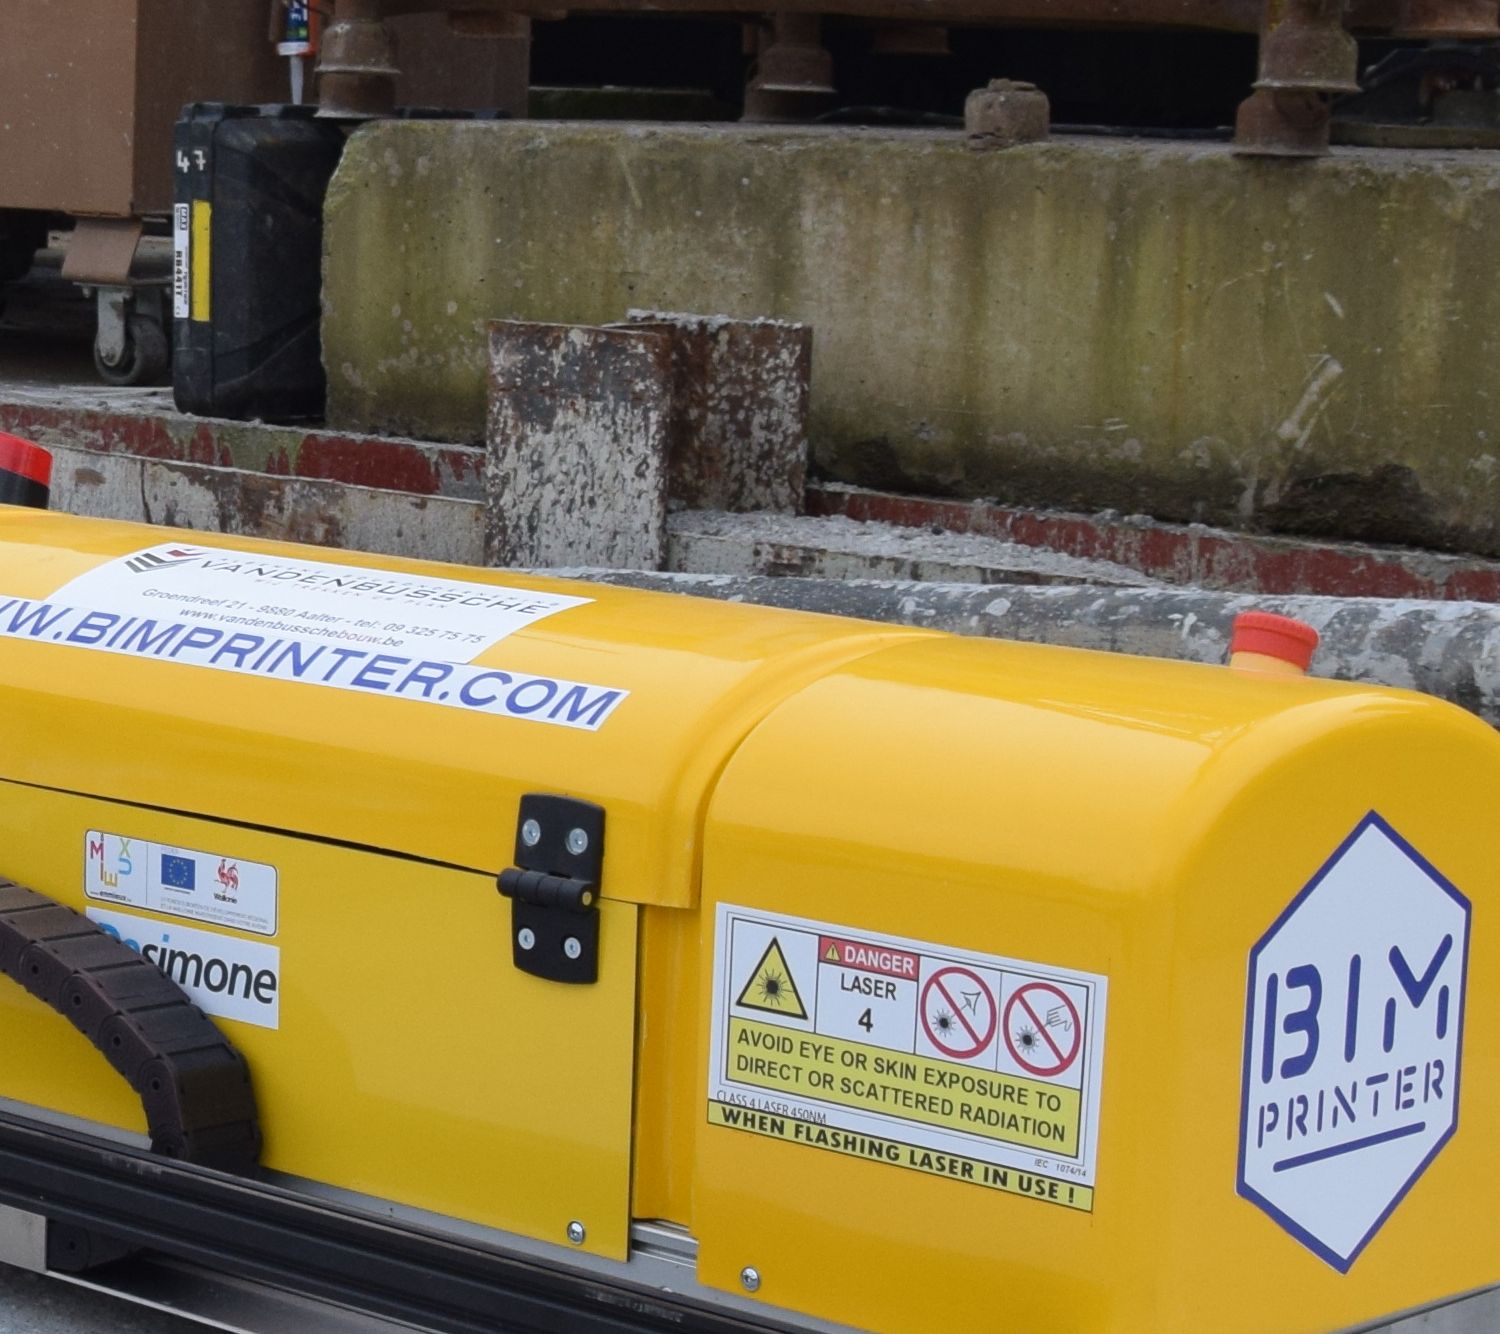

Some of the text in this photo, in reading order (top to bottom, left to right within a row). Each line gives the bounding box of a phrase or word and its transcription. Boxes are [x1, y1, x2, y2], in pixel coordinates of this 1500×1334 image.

[142, 588, 229, 607] Groendreef
[225, 599, 248, 611] 21
[255, 604, 296, 617] 9880
[296, 609, 346, 624] Aalter
[353, 618, 381, 629] tel:
[382, 622, 406, 633] 09
[405, 625, 439, 637] 325
[440, 630, 462, 641] 75
[462, 633, 487, 644] 75
[201, 560, 550, 615] VANDENBUSSCHE
[98, 922, 277, 1004] simone
[840, 972, 897, 1001] LASER
[844, 945, 915, 975] DANGER
[858, 1008, 874, 1033] 4
[1261, 933, 1453, 1084] BIM
[716, 1090, 747, 1107] CLASS
[749, 1098, 756, 1107] 4
[758, 1098, 789, 1116] LASER
[736, 1054, 1066, 1143] DIRECT OR SCATTERED RADIATION
[737, 1028, 1062, 1113] AVOID EYE OR SKIN EXPOSURE TO
[1257, 1059, 1445, 1149] PRINTER
[721, 1106, 785, 1136] WHEN
[794, 1122, 900, 1162] FLASHING
[908, 1149, 974, 1180] LASER
[983, 1168, 1008, 1188] IN
[1017, 1175, 1059, 1200] USE
